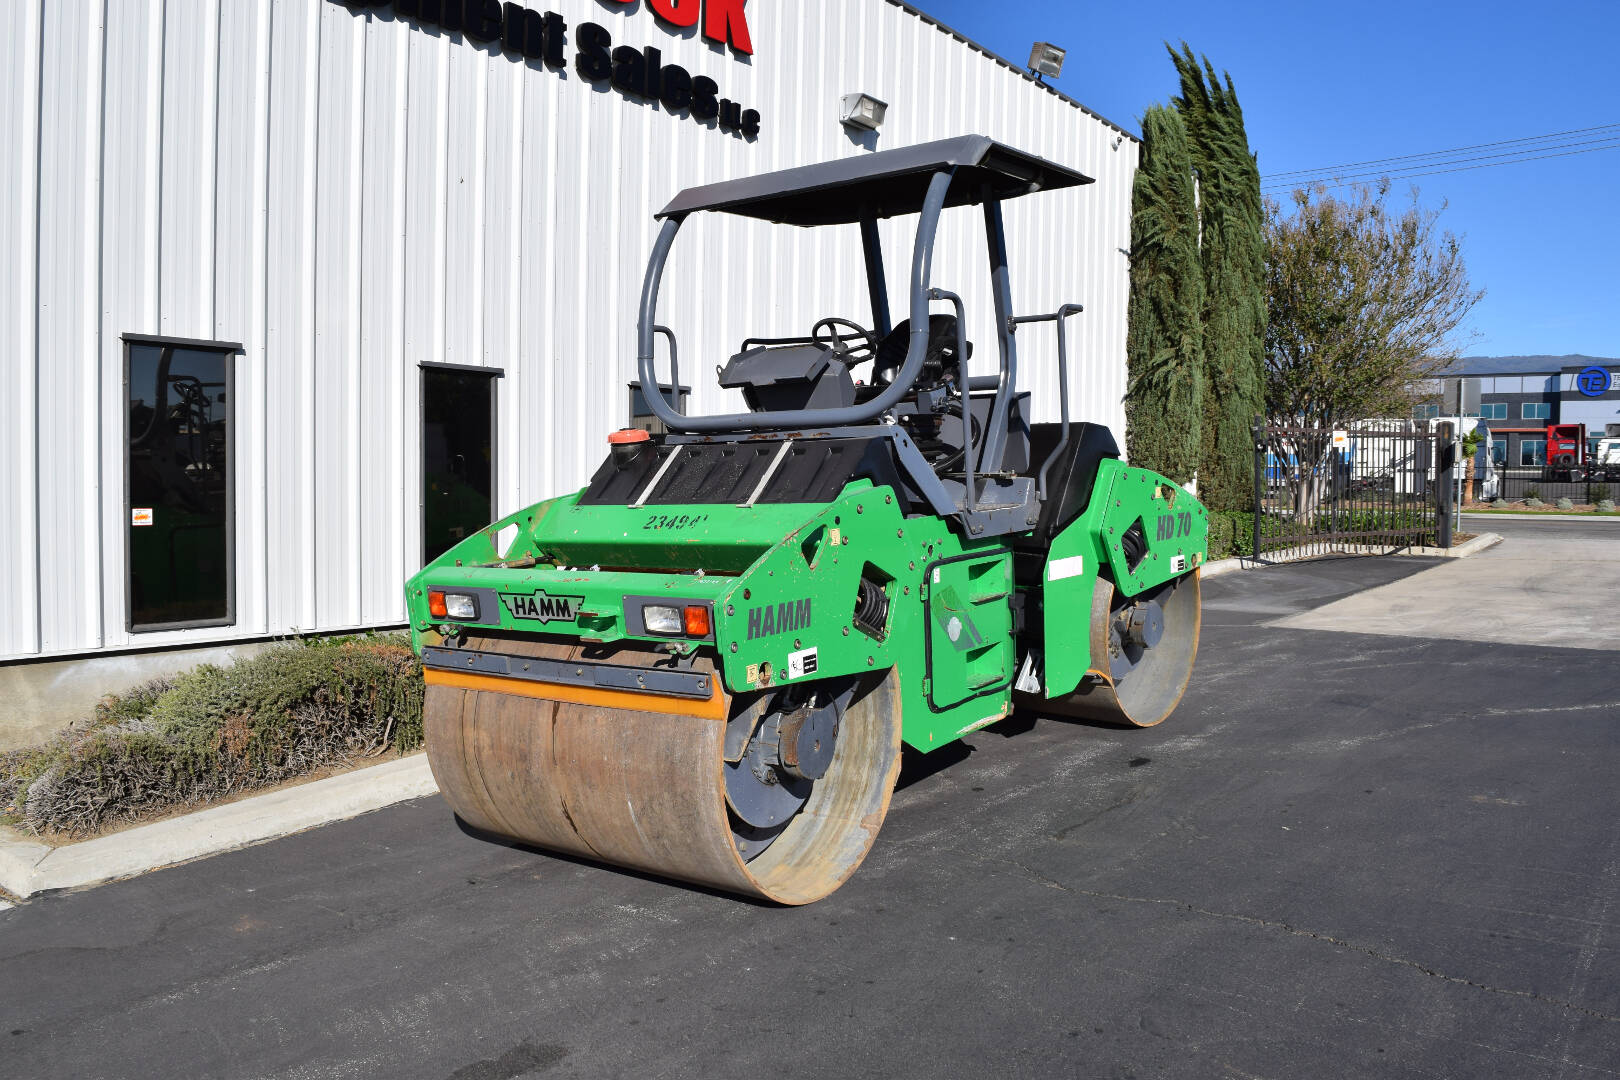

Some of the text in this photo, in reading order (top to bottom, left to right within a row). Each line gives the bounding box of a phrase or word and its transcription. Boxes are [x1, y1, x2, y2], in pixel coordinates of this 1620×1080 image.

[575, 22, 719, 119] Sales
[1157, 511, 1192, 542] HD 70
[513, 596, 572, 618] HAMM
[747, 597, 812, 640] HAMM
